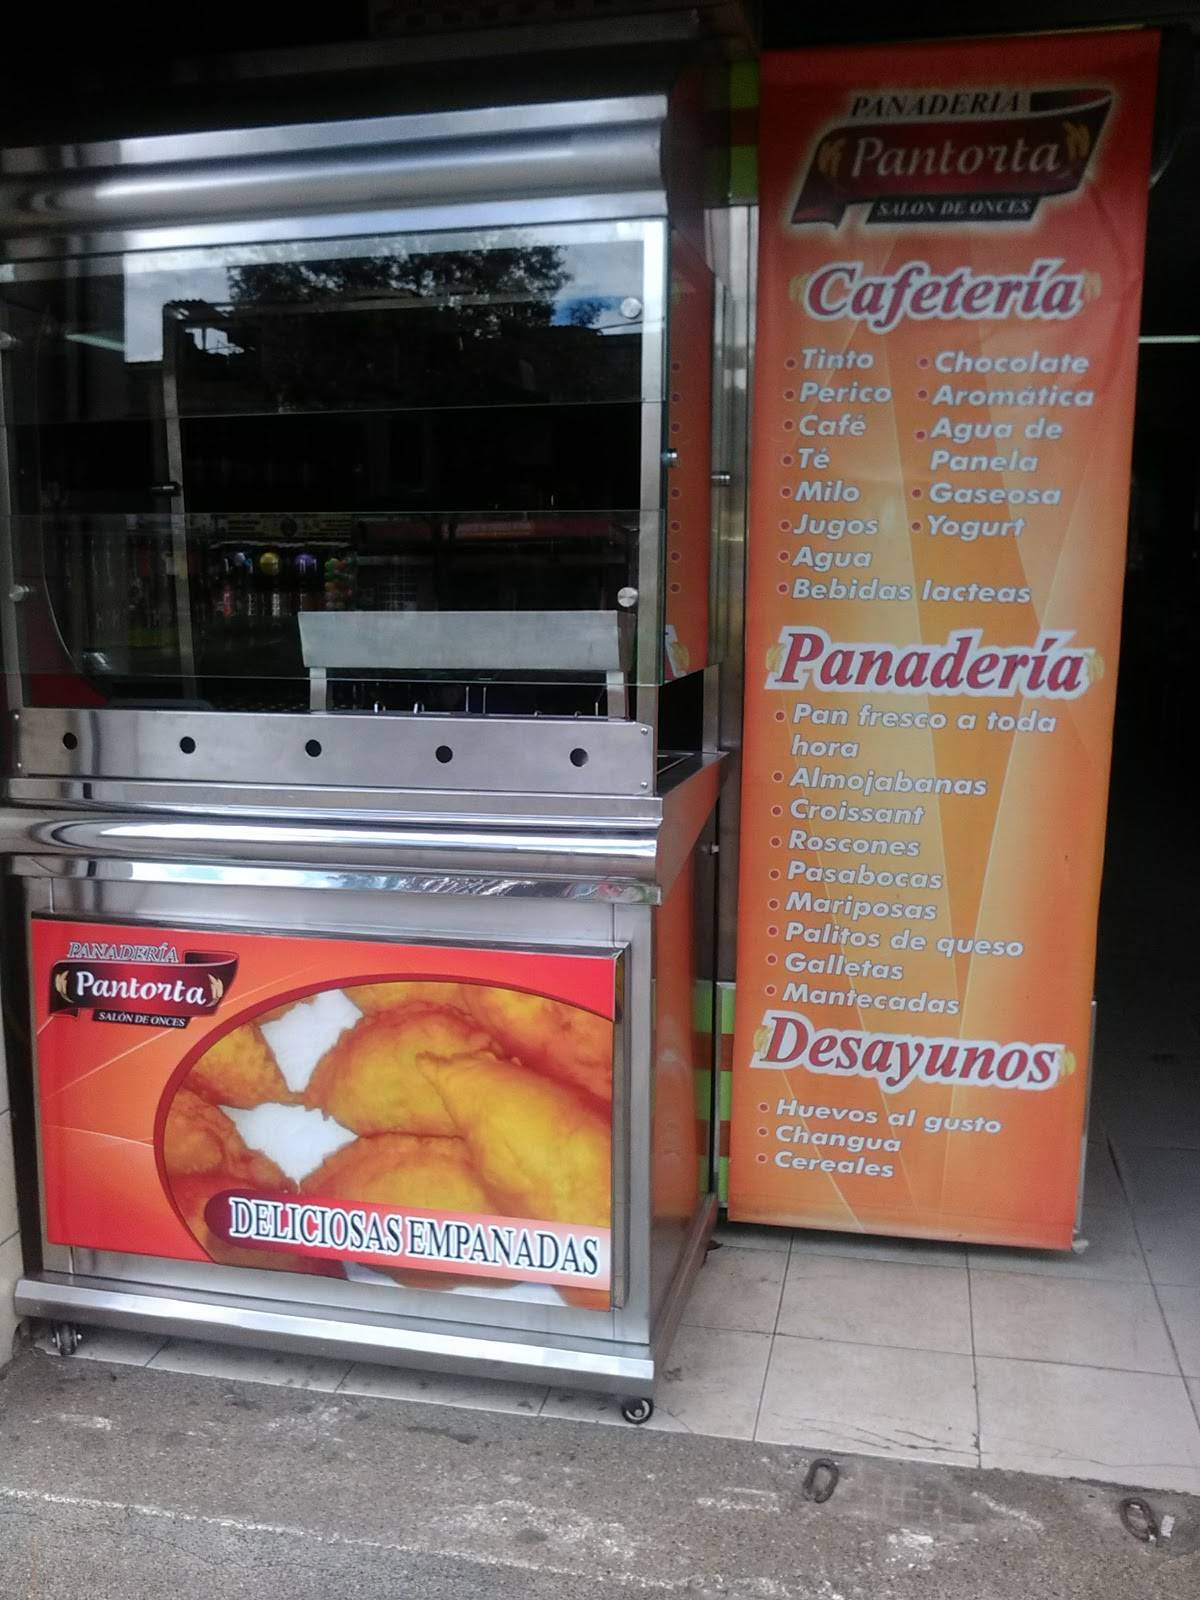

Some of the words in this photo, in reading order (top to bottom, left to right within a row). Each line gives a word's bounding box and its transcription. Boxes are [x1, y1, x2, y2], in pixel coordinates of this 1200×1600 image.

[850, 136, 1061, 178] Pantorta
[939, 200, 966, 216] DE
[969, 198, 1032, 216] ONCES
[807, 261, 1081, 329] Cafetería
[800, 348, 875, 370] Tinto
[934, 350, 1090, 375] Chocolate
[798, 380, 893, 404] Perico
[931, 384, 1095, 408] Aromática
[798, 414, 867, 437] Café
[929, 417, 1014, 444] Agua
[1023, 418, 1064, 440] de
[798, 448, 831, 470] Té
[930, 449, 1039, 473] Panela
[795, 479, 861, 502] Milo
[929, 482, 1062, 506] Gaseosa
[792, 513, 879, 540] Jugos
[926, 514, 1026, 542] Yogurt
[792, 546, 873, 572] Agua
[791, 577, 913, 601] Bebidas
[921, 579, 1033, 604] lacteas
[769, 629, 1091, 696] Panadería
[792, 702, 849, 727] Pan
[858, 704, 948, 731] fresco
[955, 713, 977, 732] a
[986, 709, 1058, 734] toda
[791, 734, 860, 759] hora
[789, 766, 989, 797] Almojabanas
[789, 798, 926, 826] Croissant
[788, 829, 921, 858] Roscones
[786, 860, 945, 891] Pasabocas
[784, 890, 938, 922] Mariposas
[66, 941, 179, 963] PANADERÍA
[784, 921, 881, 949] Palitos
[889, 929, 928, 952] de
[936, 936, 1025, 959] queso
[784, 952, 904, 981] Galletas
[75, 970, 207, 1005] Pantorta
[782, 982, 961, 1015] Mantecadas
[98, 1011, 135, 1023] SALÓN
[135, 1014, 151, 1024] DE
[150, 1016, 187, 1028] ONCES
[754, 1012, 1061, 1091] Desayunos
[775, 1098, 879, 1125] Huevos
[886, 1108, 917, 1128] al
[923, 1113, 1003, 1136] gusto
[774, 1125, 902, 1154] Changua
[773, 1150, 895, 1179] Cereales
[229, 1196, 402, 1254] DELICIOSAS
[408, 1221, 600, 1277] EMPANADAS
